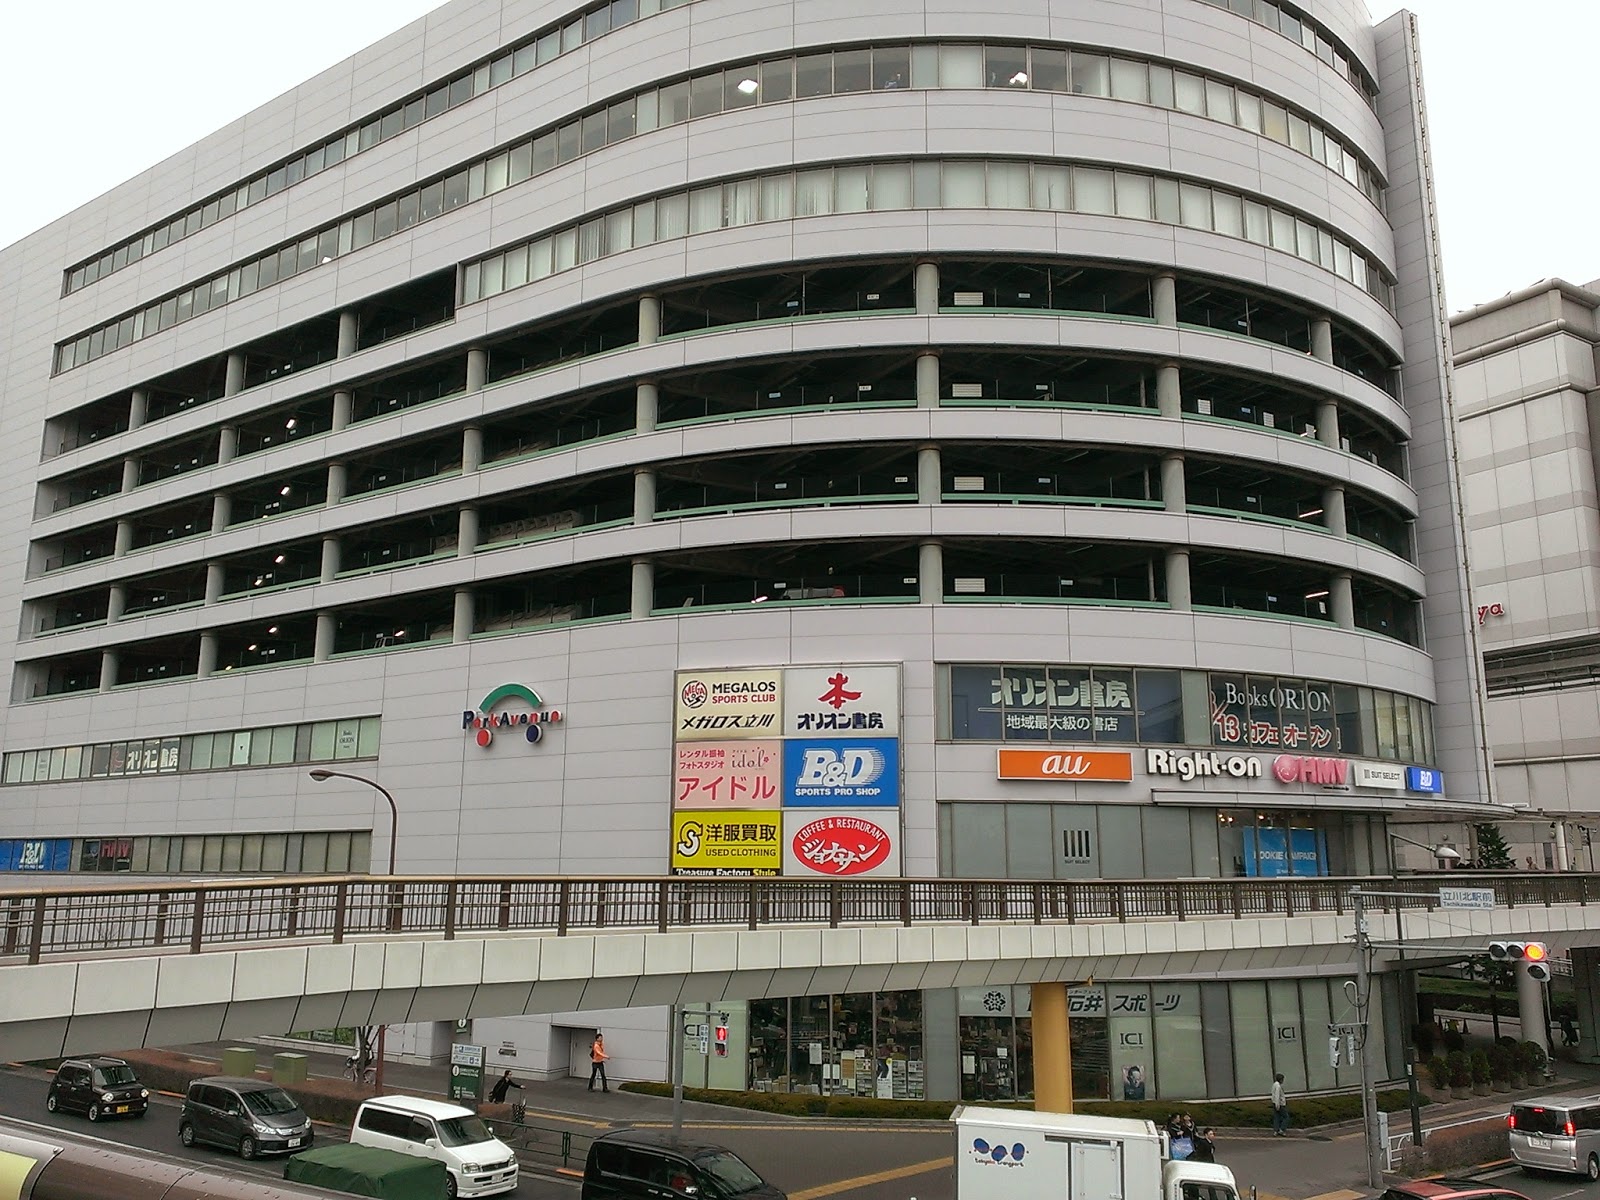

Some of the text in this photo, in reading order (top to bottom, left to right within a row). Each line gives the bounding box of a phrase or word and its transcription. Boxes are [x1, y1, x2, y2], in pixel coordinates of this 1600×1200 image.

[712, 682, 776, 694] MEGALOS
[991, 678, 1131, 708] オリオン書房
[1225, 683, 1268, 707] Books
[712, 694, 776, 704] SPORTS CLUB
[462, 710, 562, 729] ParkAvenue
[681, 714, 775, 730] メガロス立川
[797, 712, 884, 730] オリオン書房
[1006, 715, 1118, 731] 地域最大級の書店
[680, 749, 725, 758] レンタル振袖
[732, 749, 765, 768] idol
[680, 761, 725, 769] フォトスタジオ
[797, 748, 885, 787] B&D
[1041, 754, 1092, 775] au
[1146, 748, 1262, 781] Right-on
[1299, 757, 1347, 785] HMV
[1371, 770, 1400, 781] SUIT SELECT
[679, 776, 776, 801] アイドル
[795, 788, 880, 796] SPORTS PRO SHOP
[706, 824, 777, 842] 洋服買取
[798, 818, 885, 842] COFFEE & RESTAURANT
[706, 848, 776, 857] USED CLOTHING
[801, 839, 880, 873] ジョナサン
[1443, 891, 1493, 901] 立川北駅前
[1120, 1032, 1144, 1045] ICI
[1278, 1026, 1296, 1039] ICI
